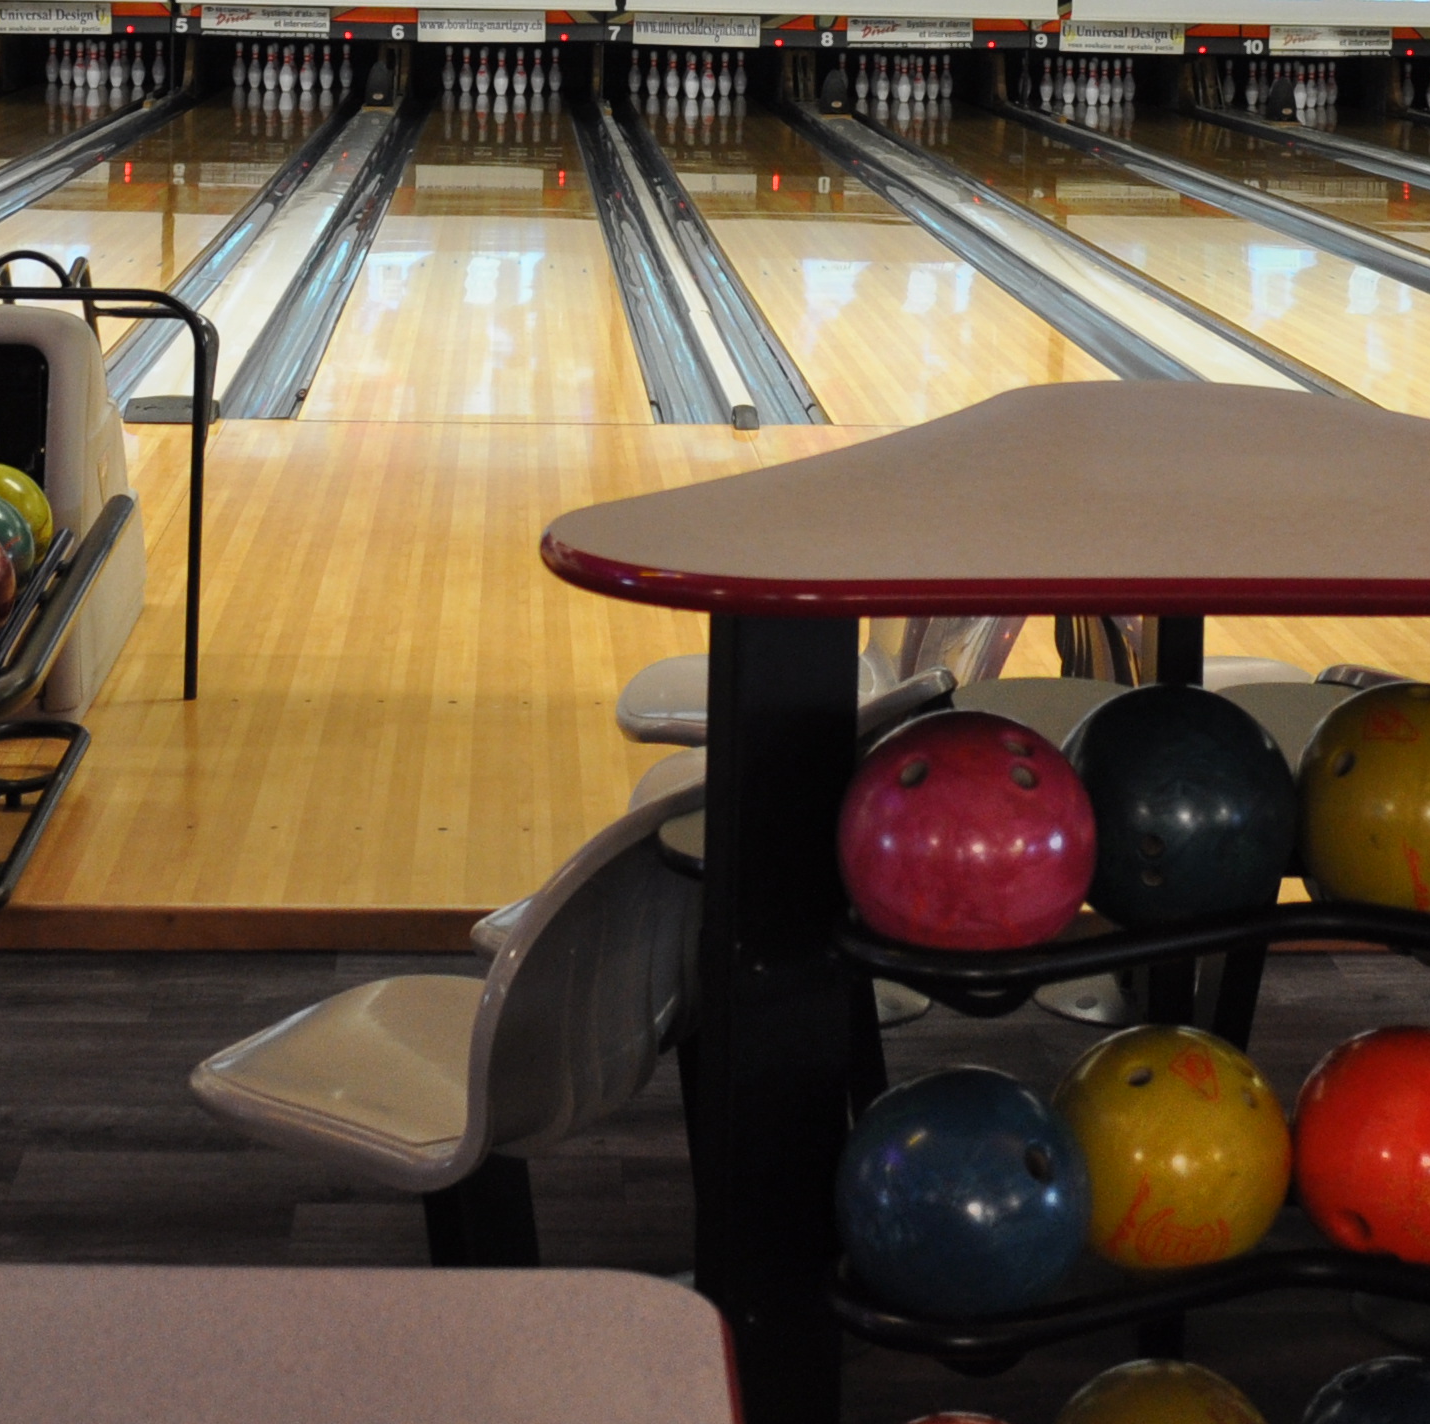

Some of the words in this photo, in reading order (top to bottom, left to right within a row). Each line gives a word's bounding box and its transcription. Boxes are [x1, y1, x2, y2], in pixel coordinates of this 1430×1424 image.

[0, 8, 52, 21] Universal
[56, 8, 94, 24] Design
[175, 18, 188, 33] 5
[391, 25, 405, 40] 6
[419, 19, 543, 33] www.bowling-martigny.ch
[608, 26, 621, 41] 7
[821, 32, 834, 47] 8
[1034, 33, 1048, 48] 9
[1076, 26, 1128, 38] Universal
[1131, 26, 1168, 43] Design
[1243, 39, 1264, 54] 10
